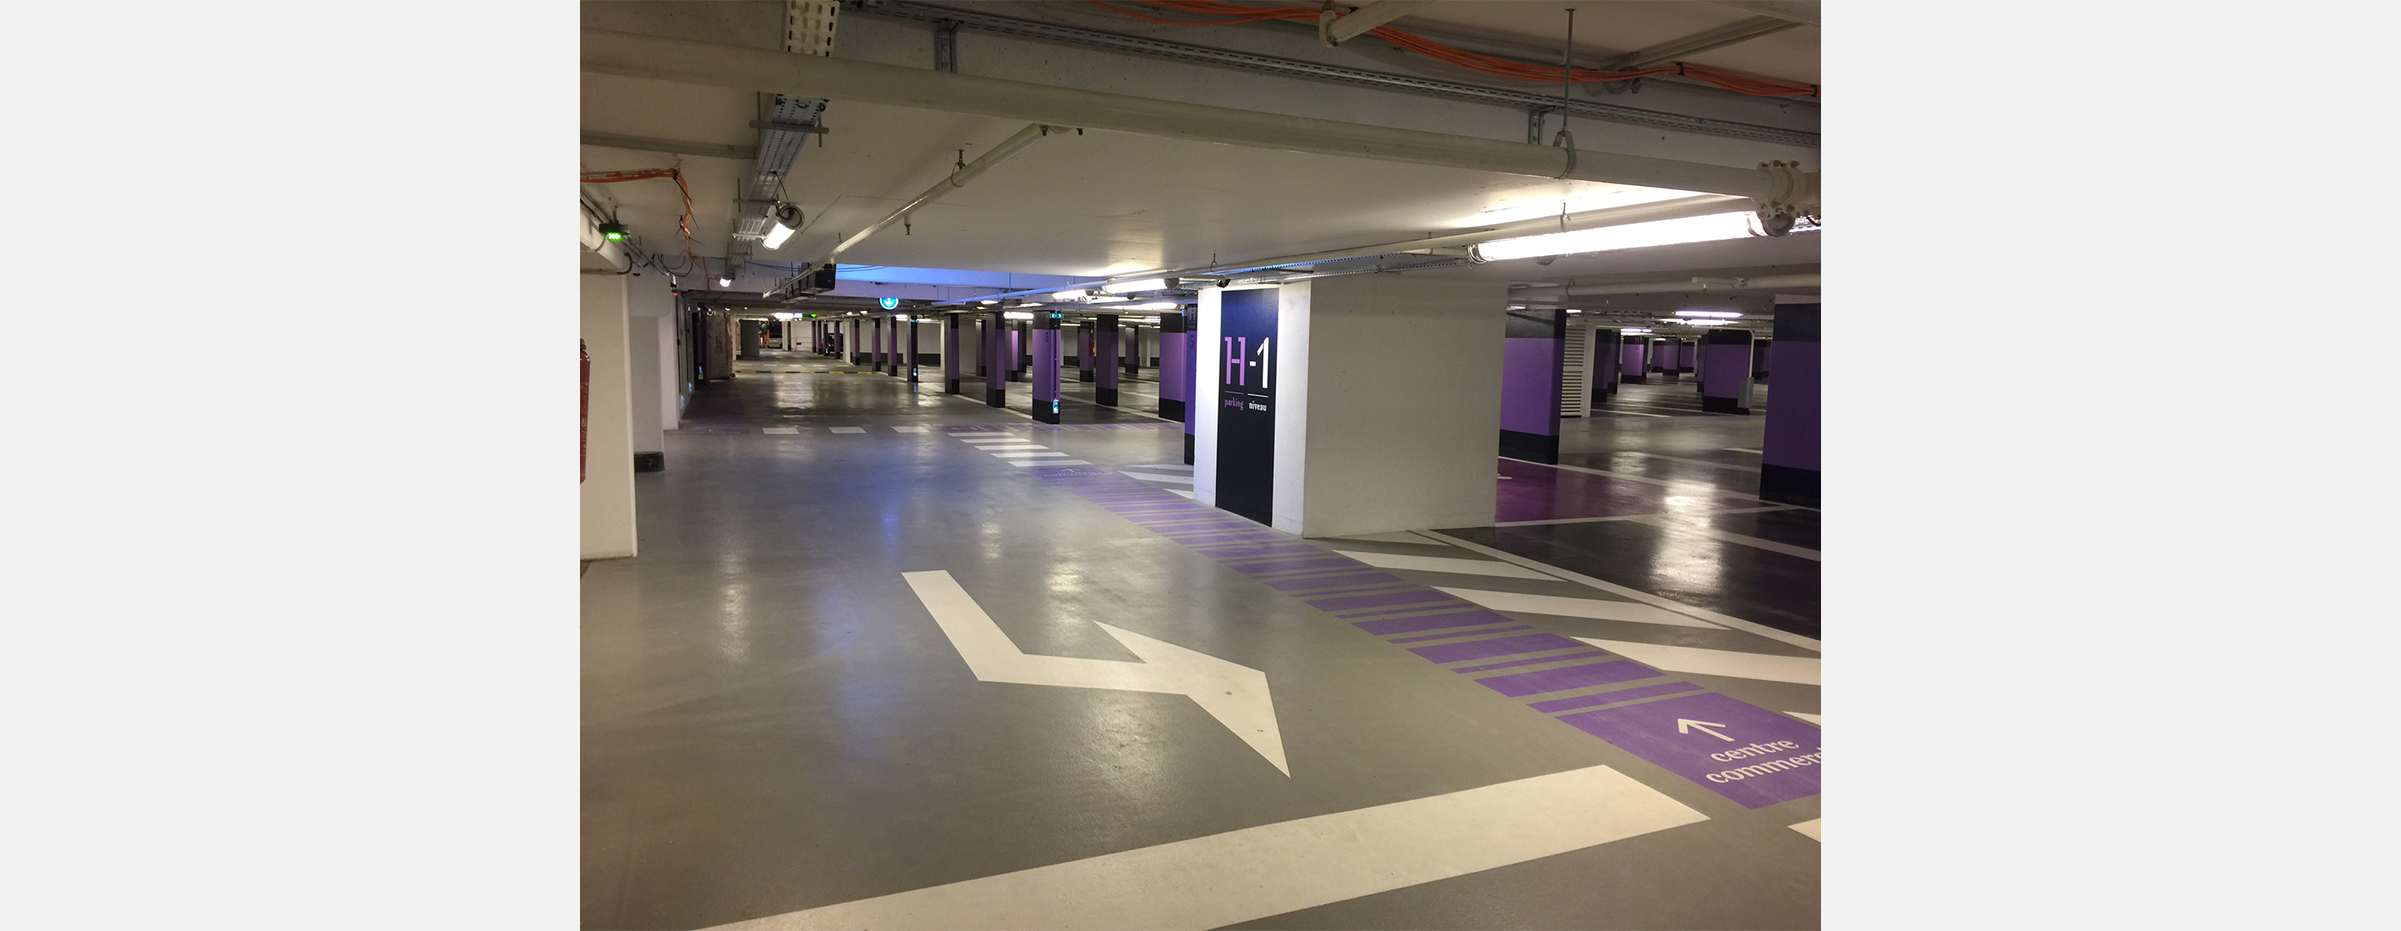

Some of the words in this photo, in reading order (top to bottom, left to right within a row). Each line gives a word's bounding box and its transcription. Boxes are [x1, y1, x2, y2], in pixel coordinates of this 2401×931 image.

[1224, 397, 1244, 411] parking
[1248, 400, 1267, 412] niveau
[1710, 740, 1799, 762] centre
